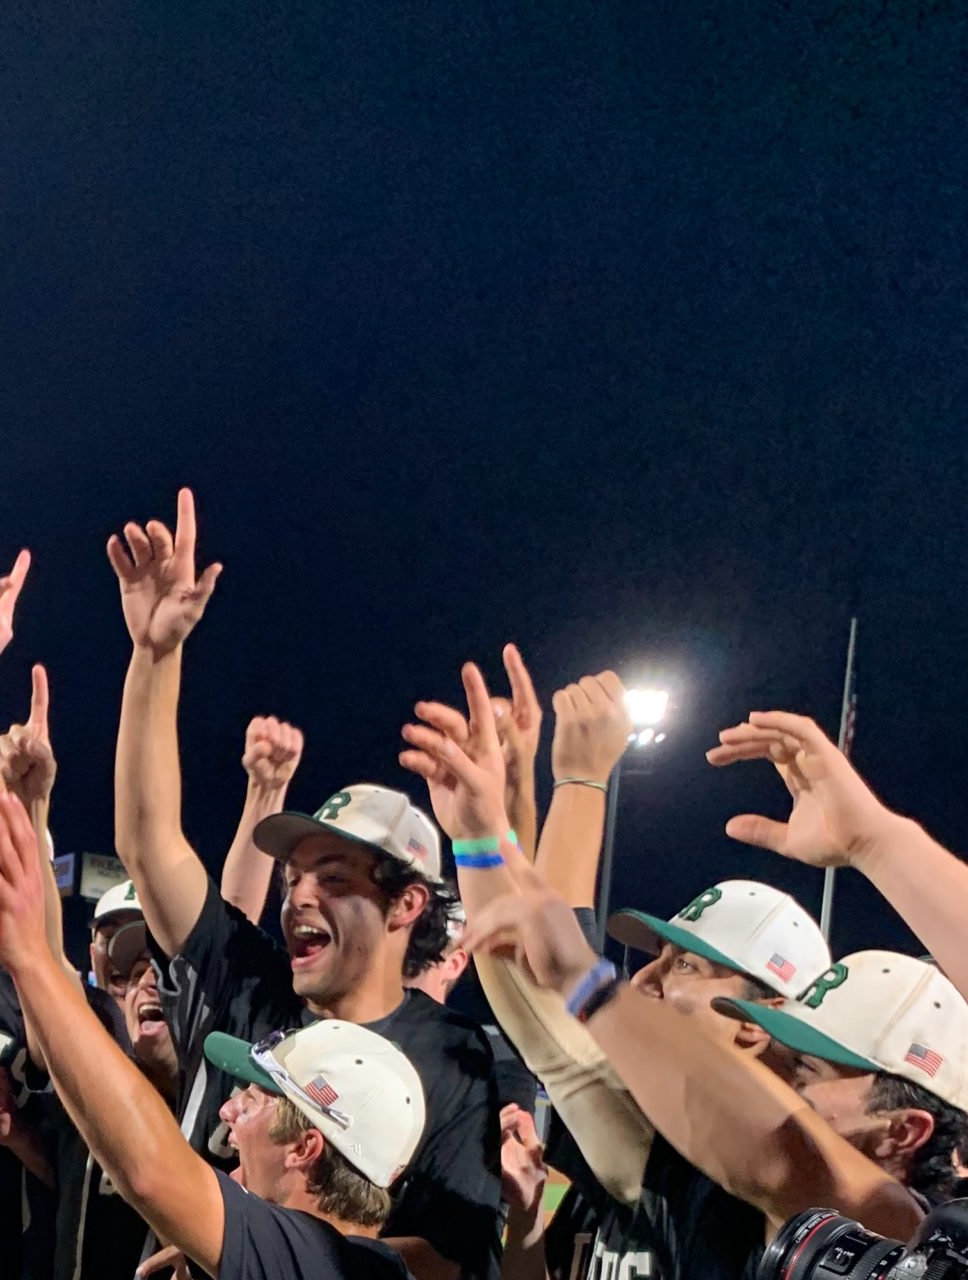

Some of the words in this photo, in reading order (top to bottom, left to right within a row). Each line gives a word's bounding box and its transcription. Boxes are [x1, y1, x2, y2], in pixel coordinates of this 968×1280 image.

[313, 791, 352, 821] R
[679, 886, 723, 922] R
[795, 962, 849, 1010] R
